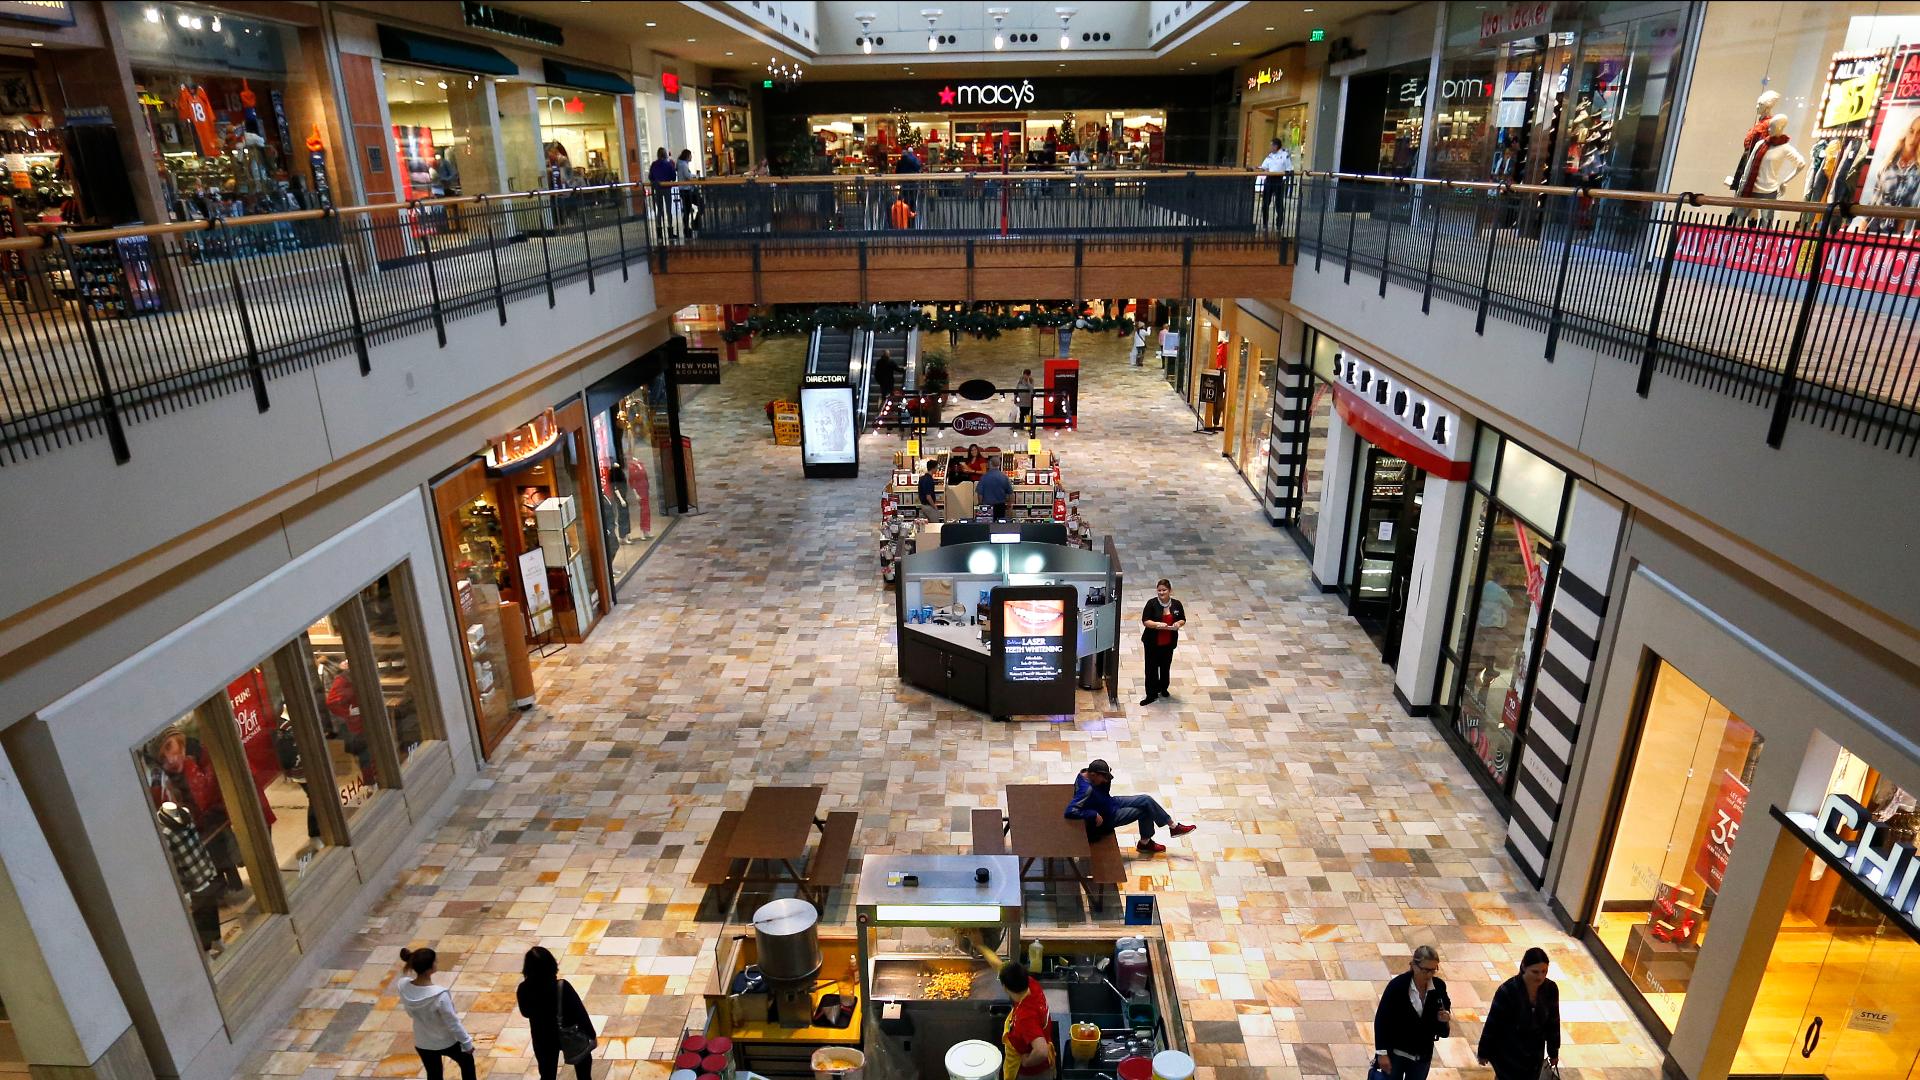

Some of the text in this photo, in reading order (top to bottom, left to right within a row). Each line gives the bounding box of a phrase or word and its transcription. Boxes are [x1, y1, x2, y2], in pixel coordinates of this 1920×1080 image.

[957, 79, 1034, 109] macy's
[191, 102, 206, 122] 18
[1826, 246, 1857, 278] ALL
[805, 375, 846, 383] DIRECTORY
[1333, 350, 1452, 445] SEPHORA
[1005, 645, 1063, 654] TEETH WHITENING
[1022, 637, 1047, 646] LASER
[234, 687, 251, 707] FUN!
[1814, 793, 1920, 930] CHI
[1646, 971, 1676, 1013] CHICO'S
[1860, 1011, 1888, 1021] STYLE
